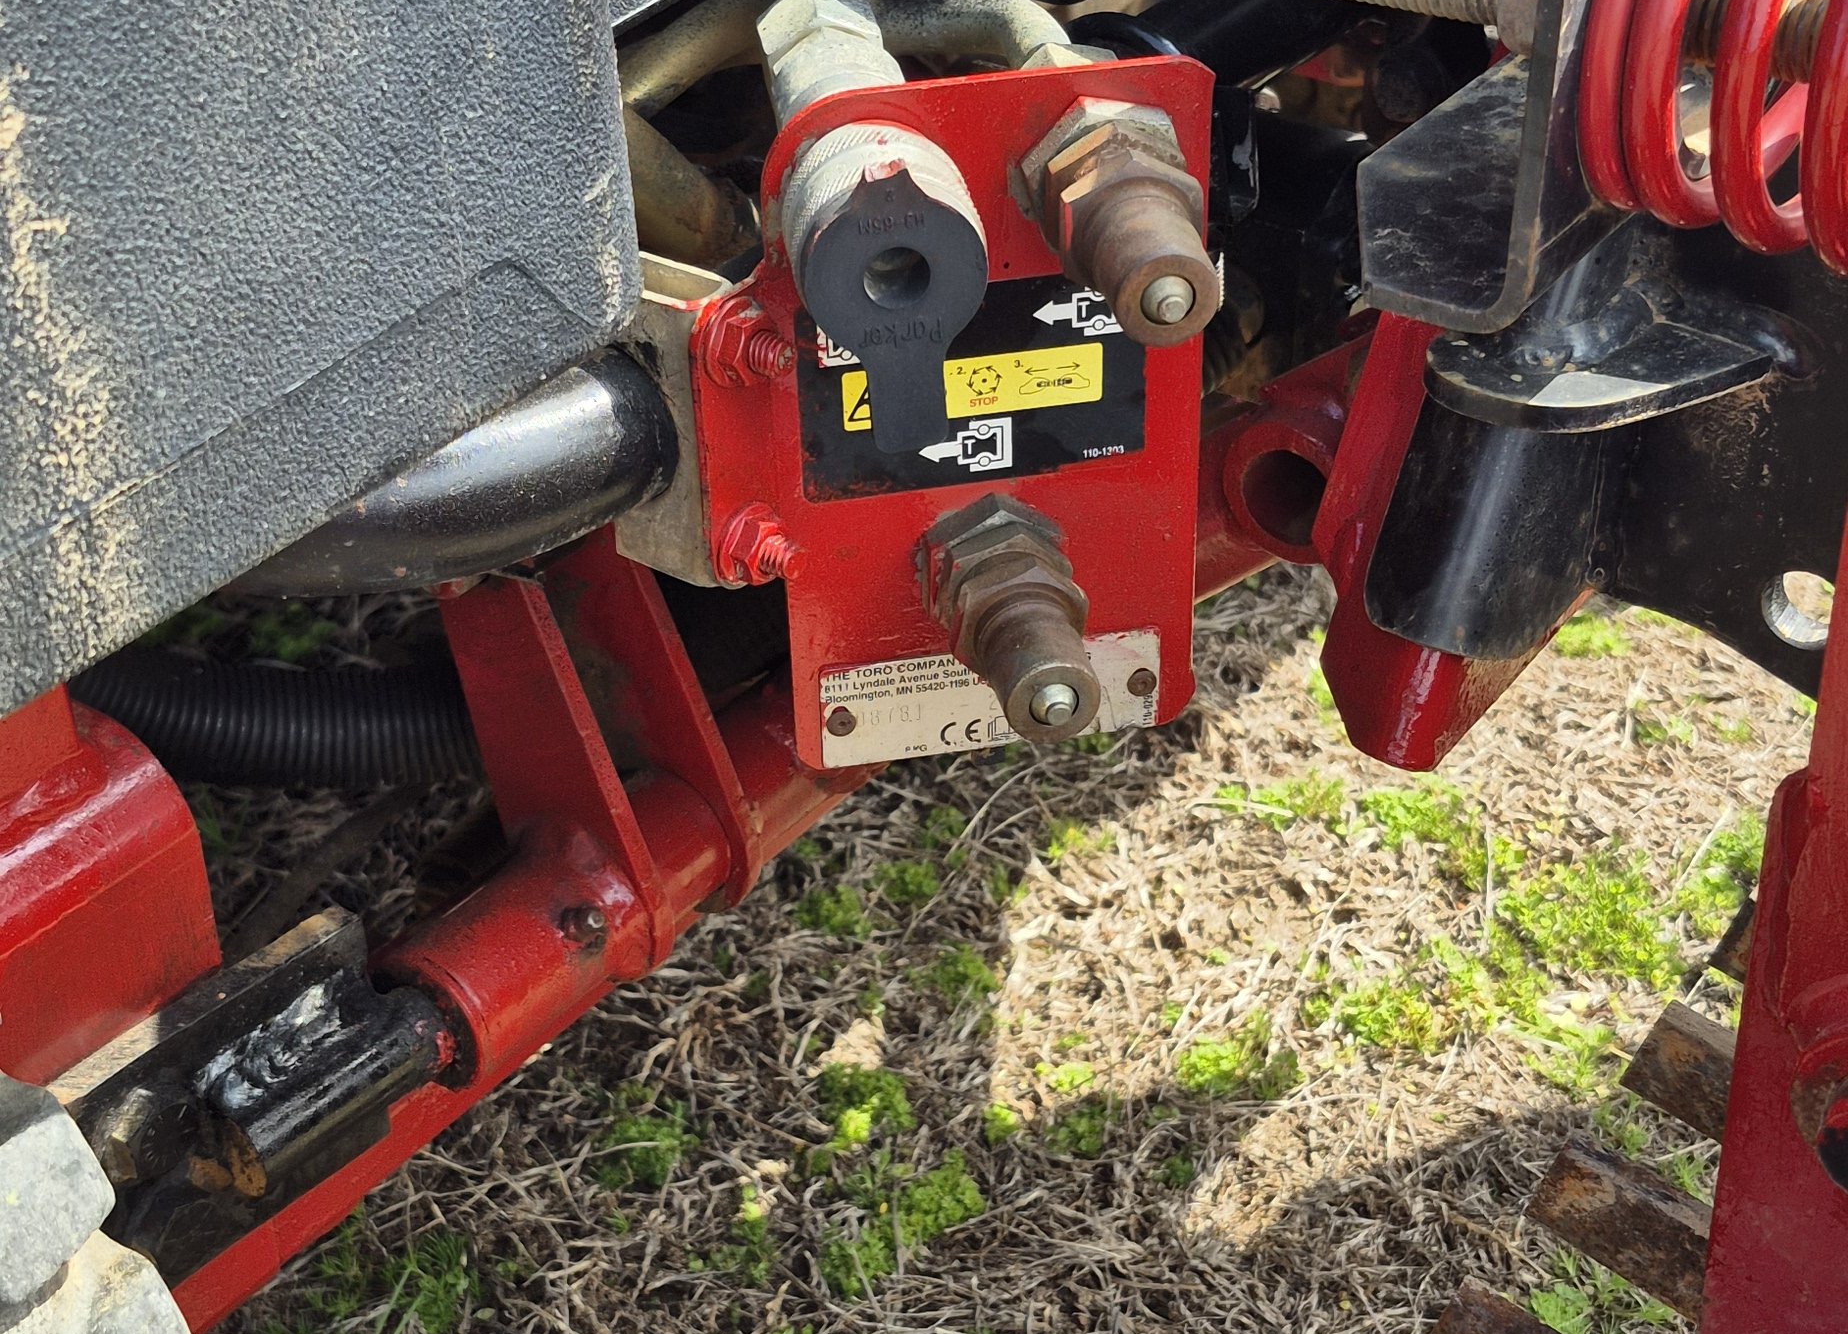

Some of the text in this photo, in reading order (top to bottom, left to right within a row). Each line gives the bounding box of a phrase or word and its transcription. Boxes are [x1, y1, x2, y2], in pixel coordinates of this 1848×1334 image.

[1078, 301, 1090, 318] T
[858, 317, 944, 348] Parker
[969, 396, 999, 407] STOP
[964, 439, 977, 455] T
[855, 666, 893, 678] TORO
[897, 658, 962, 673] COMPAN
[825, 690, 893, 703] Bloomington,
[896, 684, 912, 695] MN
[915, 679, 969, 694] 55420-1196
[853, 677, 895, 691] Lyndale
[900, 672, 939, 683] Avenue
